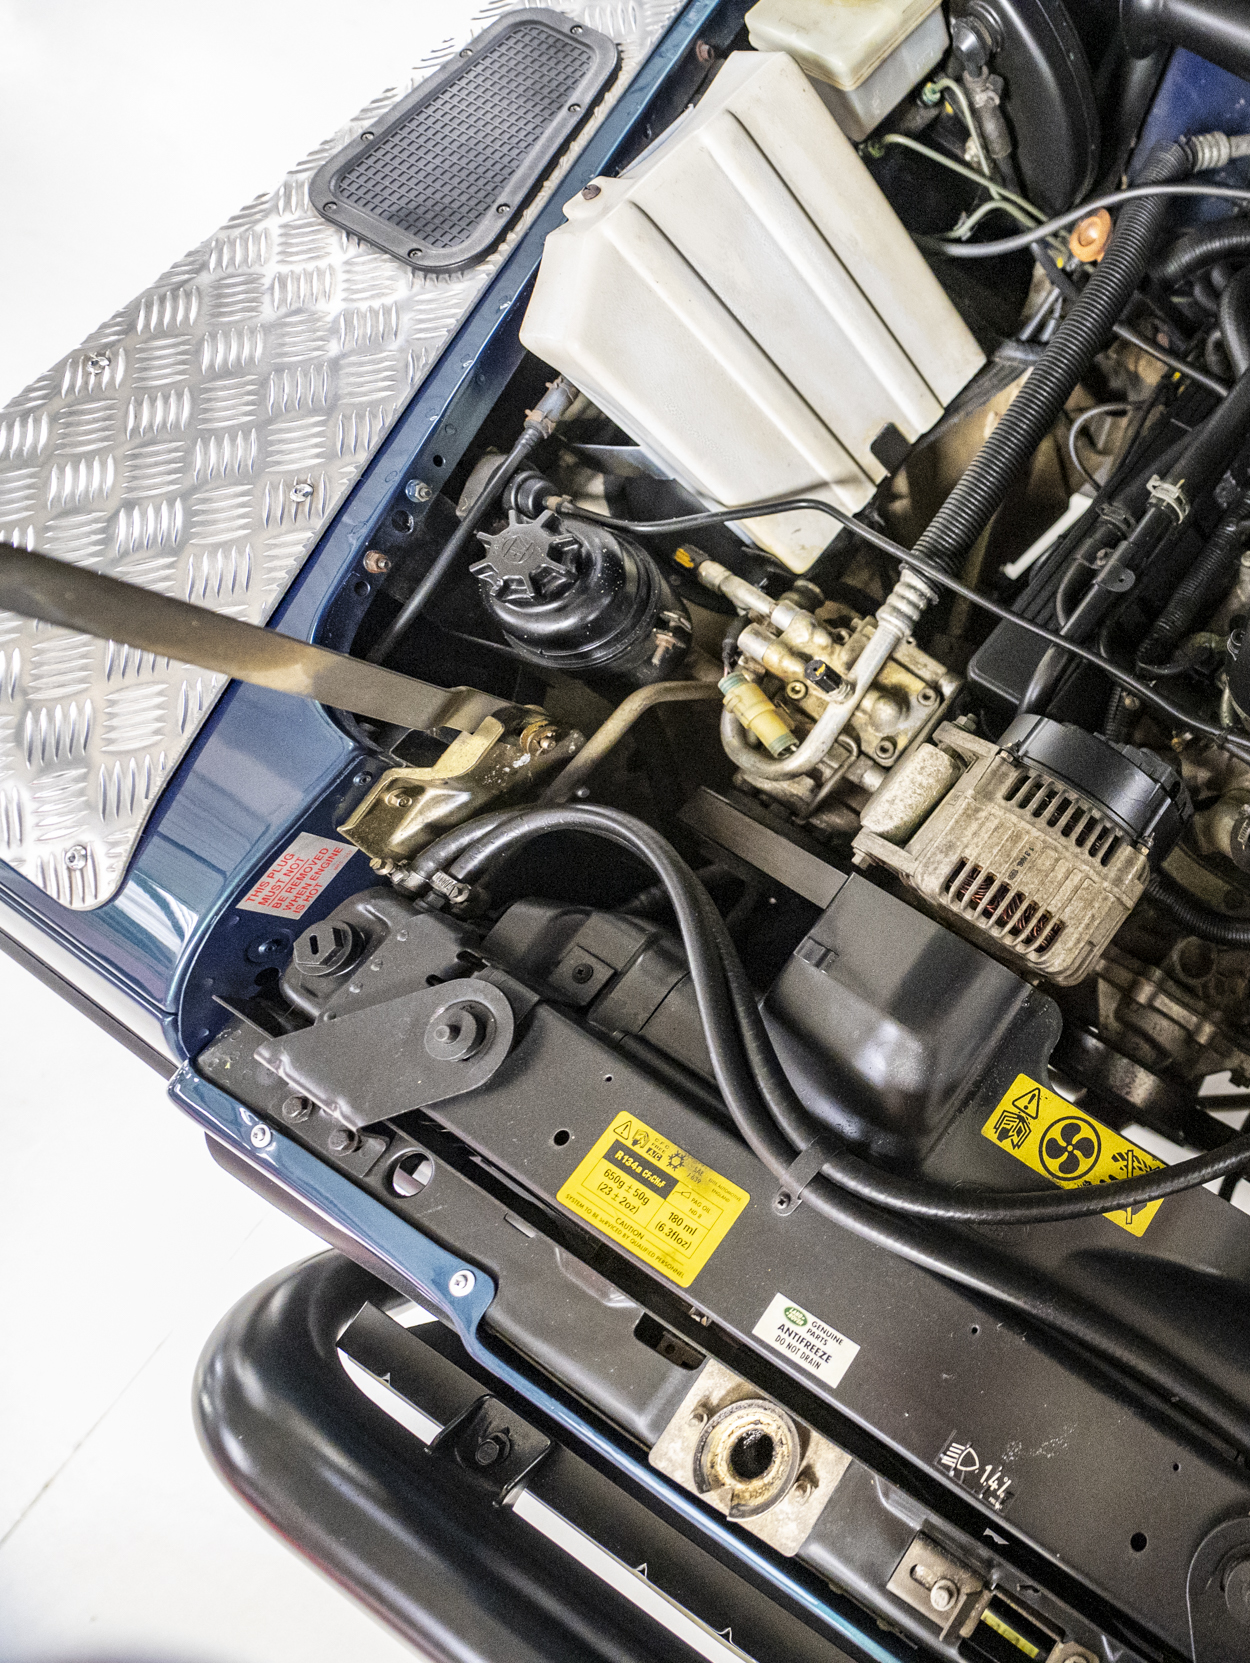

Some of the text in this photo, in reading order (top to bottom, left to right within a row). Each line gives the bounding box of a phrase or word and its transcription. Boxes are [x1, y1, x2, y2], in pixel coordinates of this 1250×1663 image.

[245, 853, 295, 902] THIS PLUG
[258, 858, 304, 906] MUST NOT
[272, 848, 329, 908] BE REMOVED
[283, 883, 312, 911] WHEN
[310, 848, 343, 881] ENGINE
[293, 884, 322, 913] IS HOT
[597, 1182, 612, 1196] (23
[619, 1196, 640, 1215] 2oz)
[603, 1169, 625, 1189] 650g
[634, 1189, 650, 1206] 50g
[691, 1198, 702, 1208] PAG
[565, 1193, 584, 1209] SYSTEM
[630, 1238, 655, 1258] QUALIFIED
[655, 1255, 685, 1278] PERSONNEL
[615, 1217, 644, 1240] CAUTION
[668, 1212, 698, 1236] 180 ml
[777, 1323, 832, 1363] ANTIFREEZE
[806, 1328, 828, 1346] PARTS
[812, 1321, 844, 1345] GENUINE
[775, 1334, 821, 1369] DO NOT DRAIN
